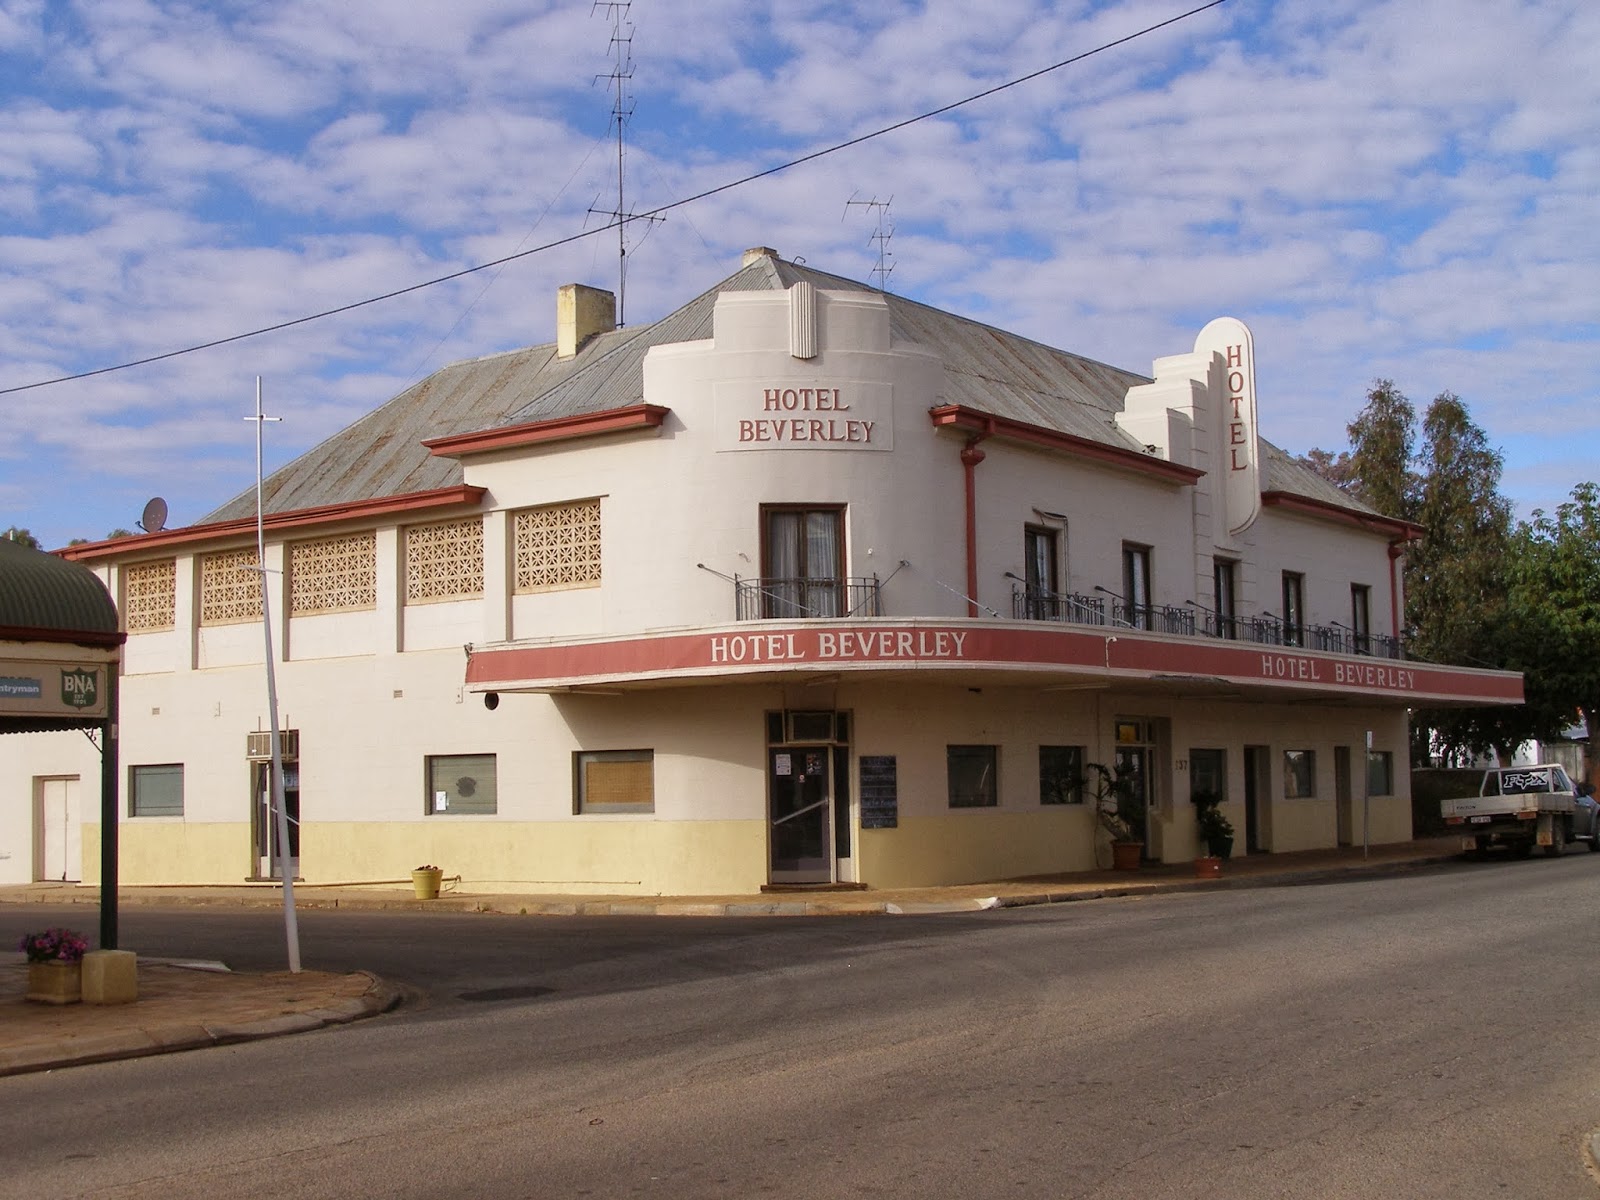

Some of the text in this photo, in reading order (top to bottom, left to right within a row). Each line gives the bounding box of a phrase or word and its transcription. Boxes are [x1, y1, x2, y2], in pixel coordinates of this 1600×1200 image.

[763, 388, 850, 411] HOTEL
[1226, 345, 1247, 471] HOTEL
[739, 419, 875, 443] BEVERLEY
[710, 631, 967, 662] HOTEL BEVERLEY
[64, 674, 95, 694] BNA
[1261, 655, 1414, 689] HOTEL BEVERLEY
